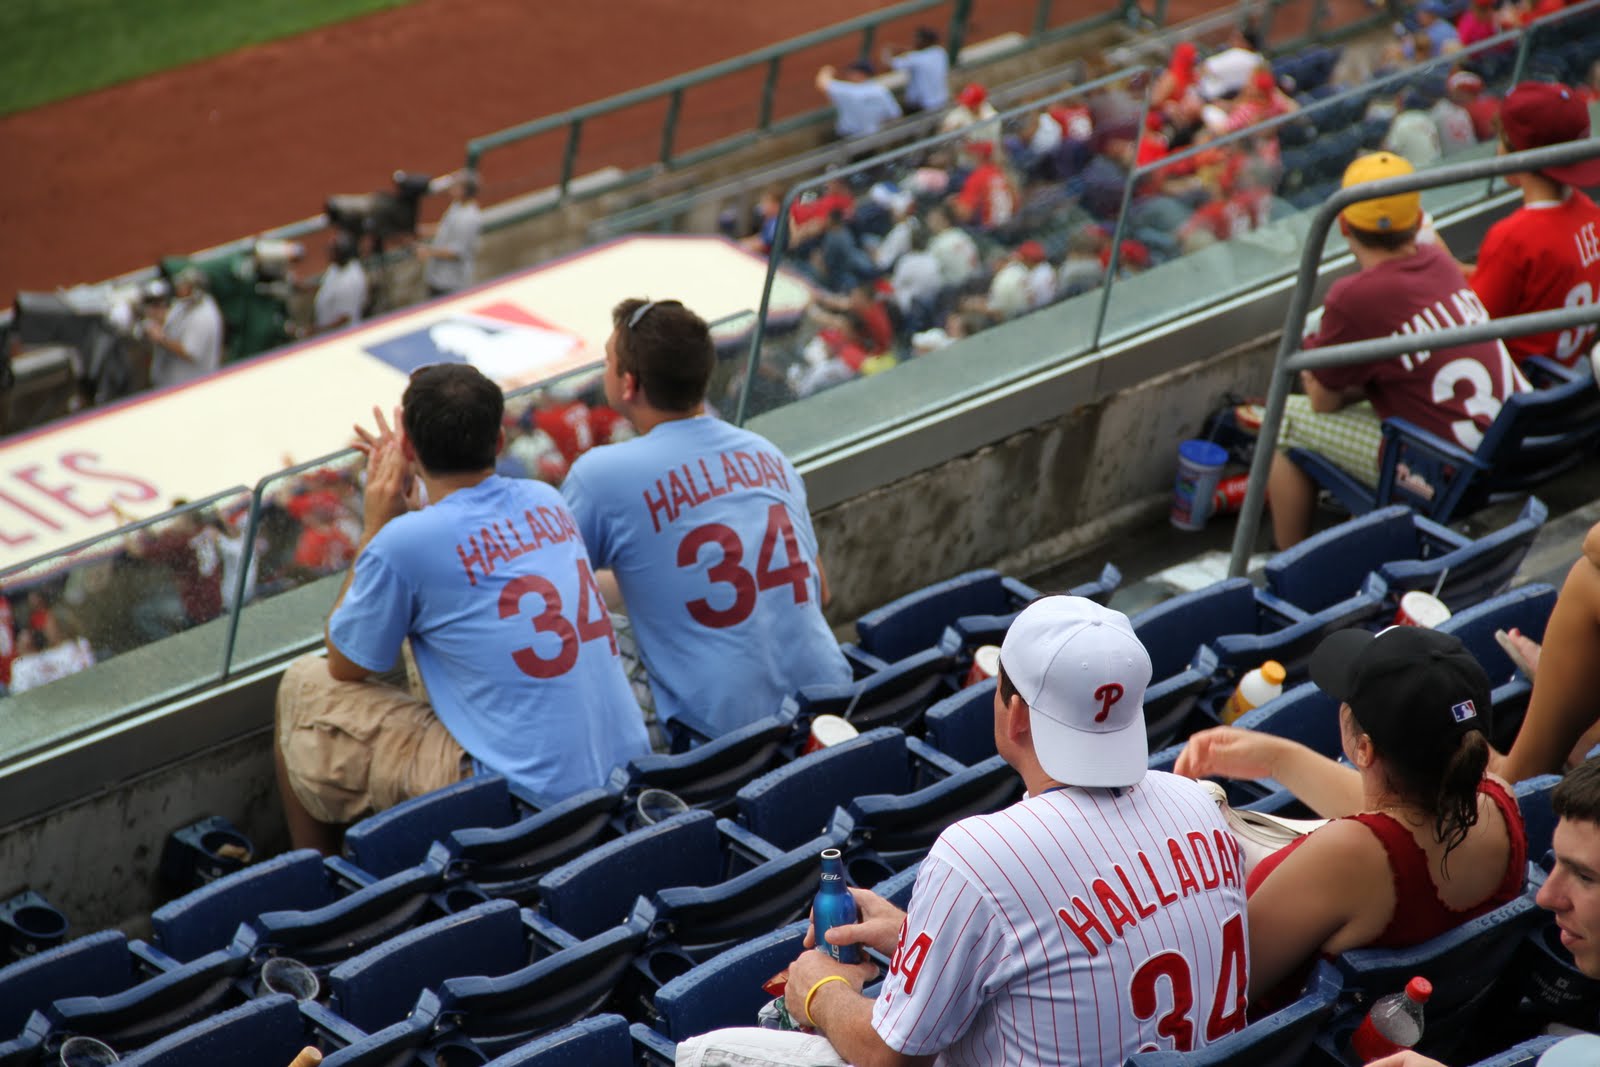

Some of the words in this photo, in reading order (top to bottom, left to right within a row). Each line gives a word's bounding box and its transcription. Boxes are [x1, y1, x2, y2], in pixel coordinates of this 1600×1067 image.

[0, 450, 159, 546] IES
[456, 506, 582, 586] HALLADA
[643, 451, 791, 534] HALLADAY
[498, 558, 619, 679] 34
[677, 502, 811, 629] 34
[1094, 682, 1125, 723] P
[1058, 829, 1241, 957] HALLADAY
[1129, 911, 1248, 1051] 34
